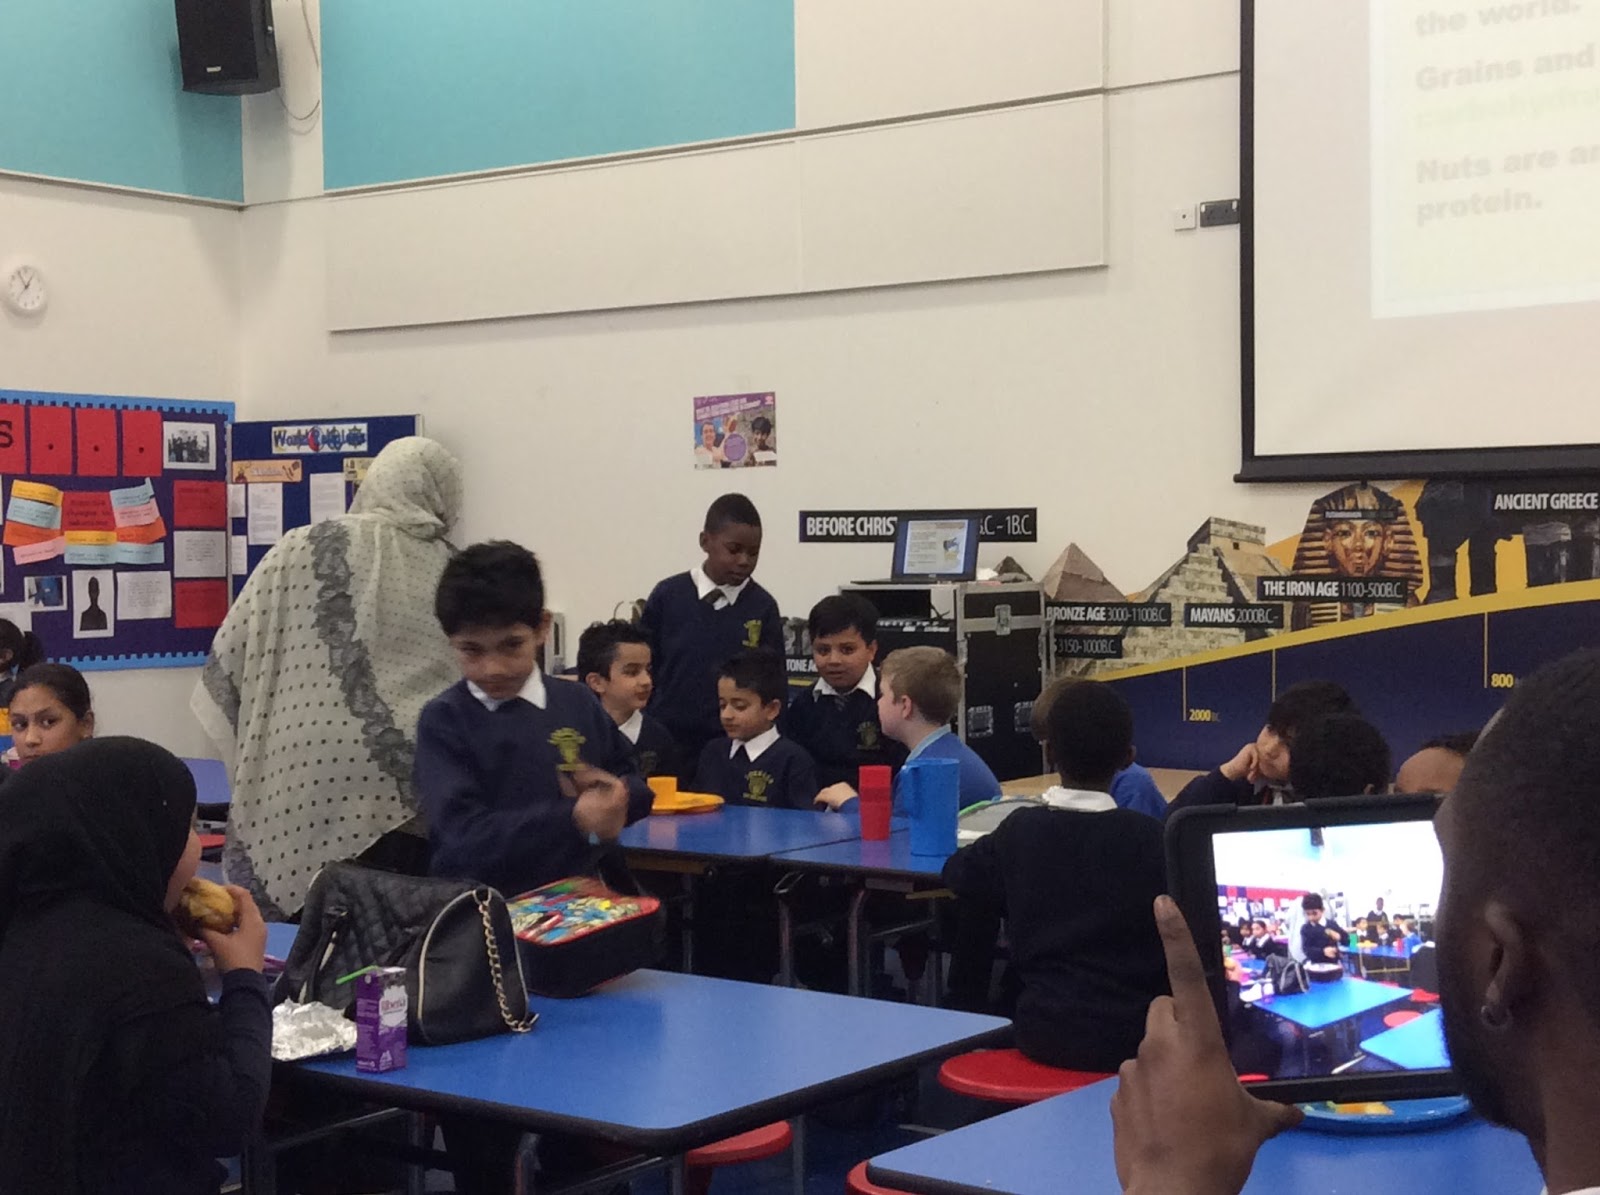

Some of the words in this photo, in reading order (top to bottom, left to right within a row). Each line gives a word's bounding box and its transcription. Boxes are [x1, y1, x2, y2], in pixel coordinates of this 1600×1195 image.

[1415, 10, 1468, 36] the
[1478, 0, 1581, 26] world.
[1415, 59, 1522, 91] Grains
[1535, 42, 1596, 74] and
[1415, 155, 1492, 184] Nuts
[1503, 149, 1559, 173] are
[1415, 188, 1544, 228] protein.
[1494, 493, 1550, 510] ANCIENT
[1550, 492, 1599, 510] GREECE
[806, 516, 855, 536] BEFORE
[1263, 580, 1285, 597] THE
[1286, 580, 1315, 597] IRON
[1316, 580, 1339, 597] AGE
[1046, 606, 1086, 622] BRONZE
[1086, 606, 1107, 622] AGE
[1190, 607, 1235, 623] MAYANS
[785, 658, 807, 672] TONE
